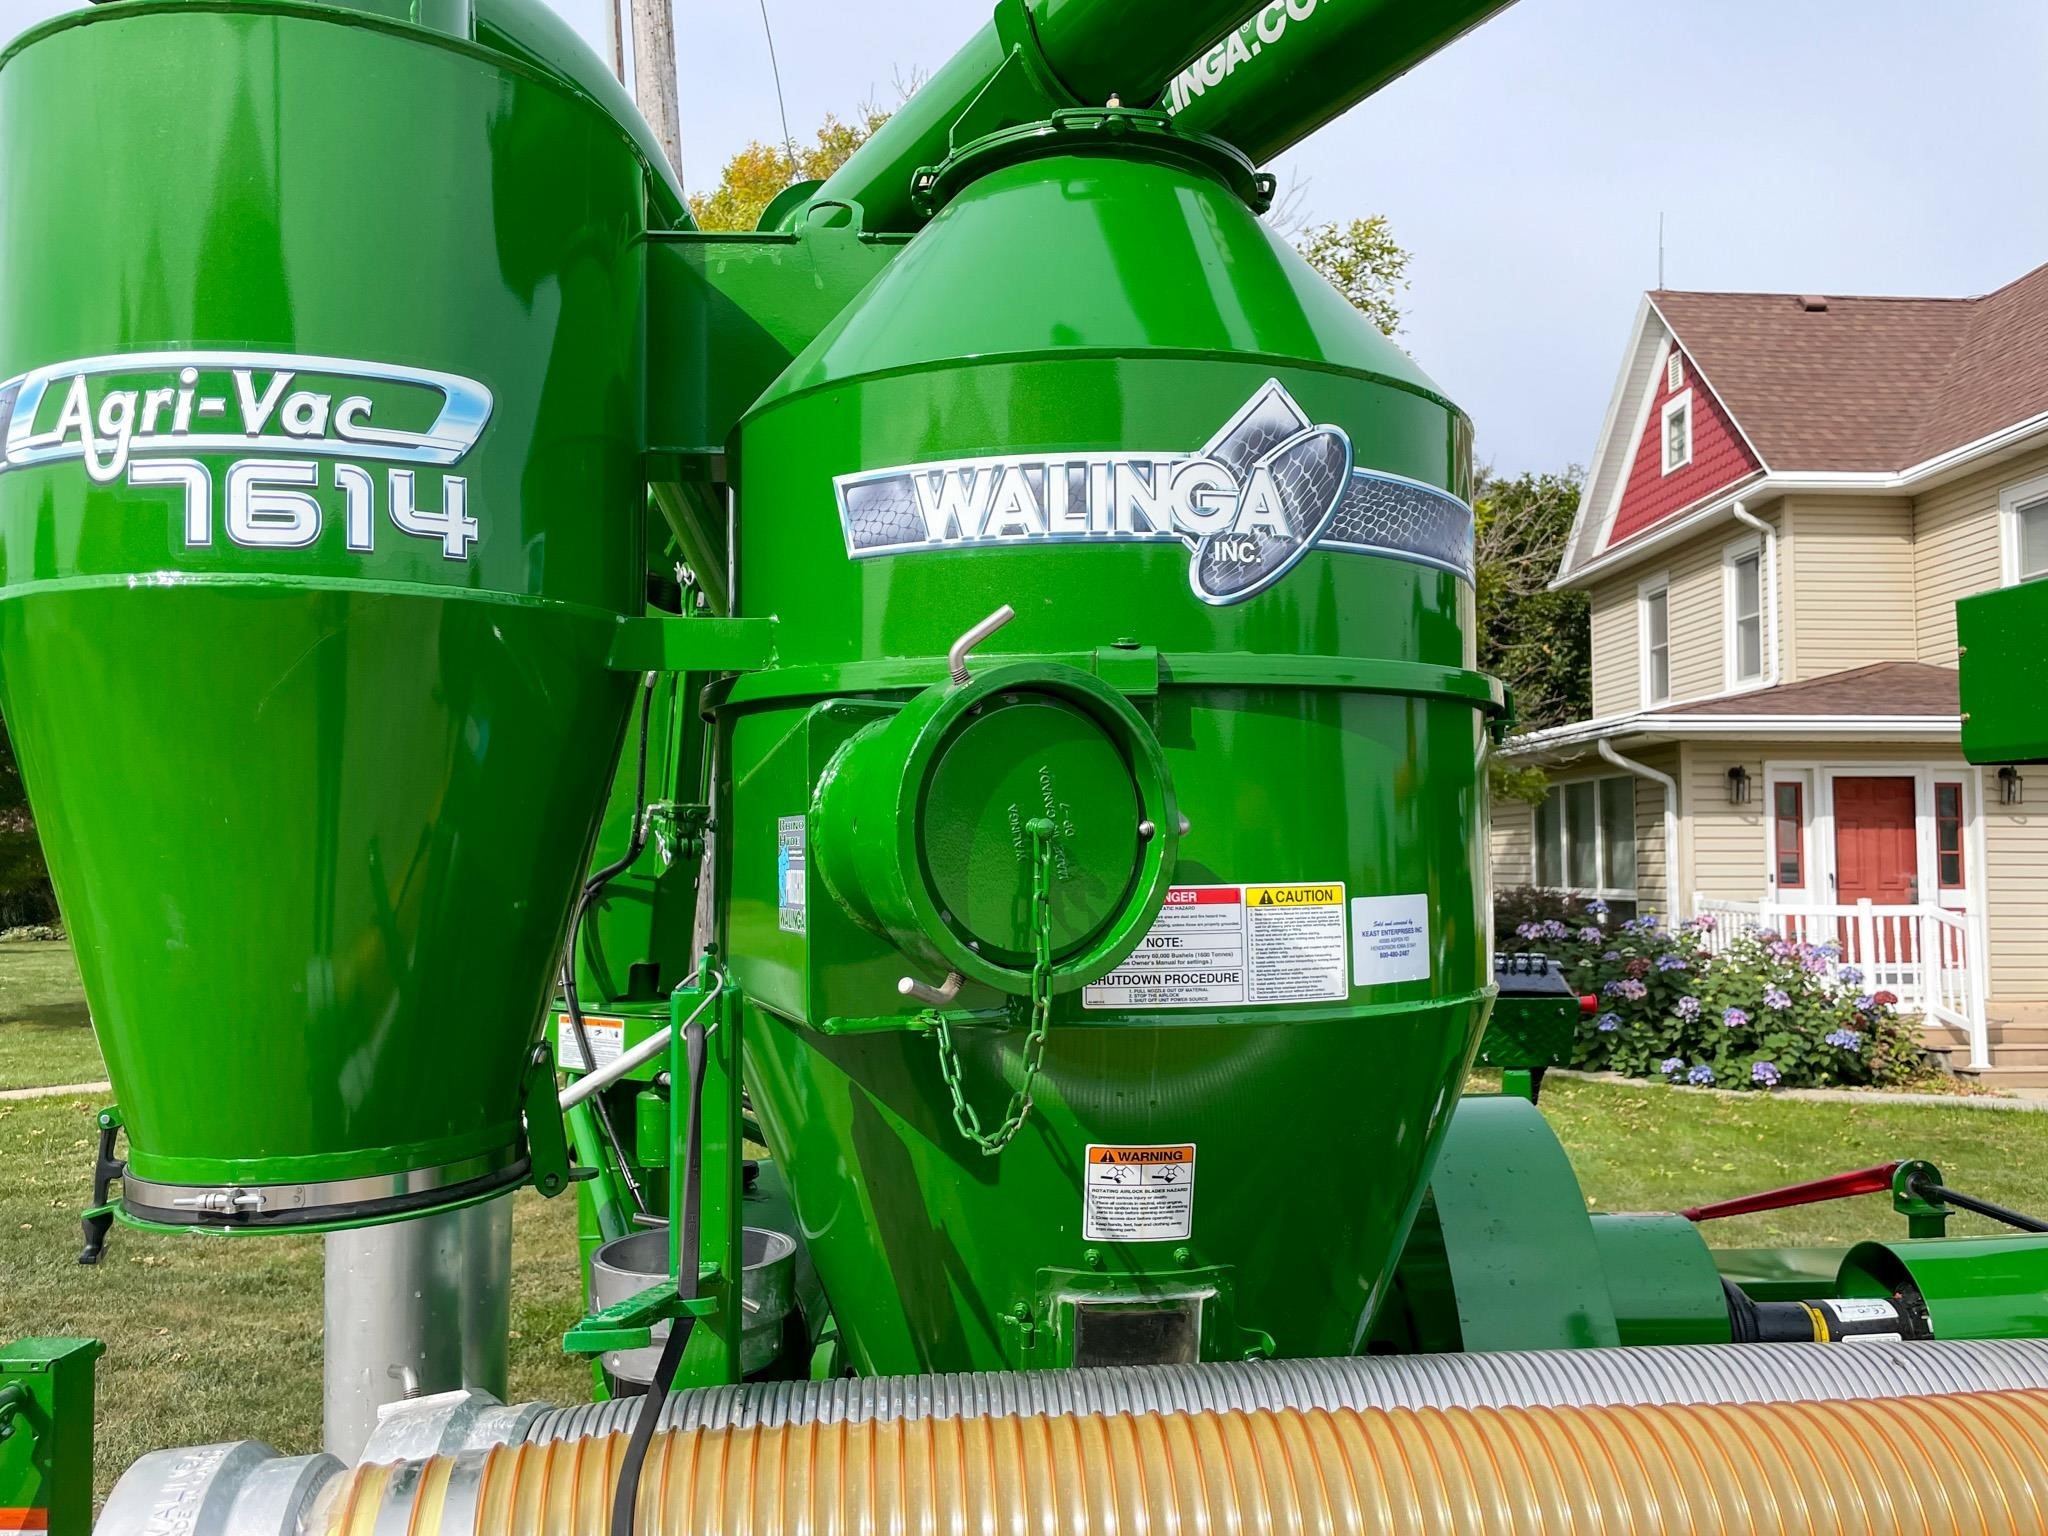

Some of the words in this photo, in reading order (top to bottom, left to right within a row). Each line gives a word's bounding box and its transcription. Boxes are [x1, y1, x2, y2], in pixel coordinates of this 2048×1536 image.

[24, 366, 376, 482] Agri-Vac
[912, 456, 1293, 543] WALINGA
[128, 458, 478, 560] 7614
[1214, 541, 1262, 563] INC.
[1039, 765, 1056, 818] CANADA
[1166, 892, 1197, 902] NGER
[1276, 890, 1333, 902] CAUTION
[1381, 928, 1414, 936] ENTERPRISES
[1147, 938, 1183, 947] NOTE:
[1165, 973, 1239, 984] PROCEDURE
[1118, 1151, 1182, 1161] WARNING
